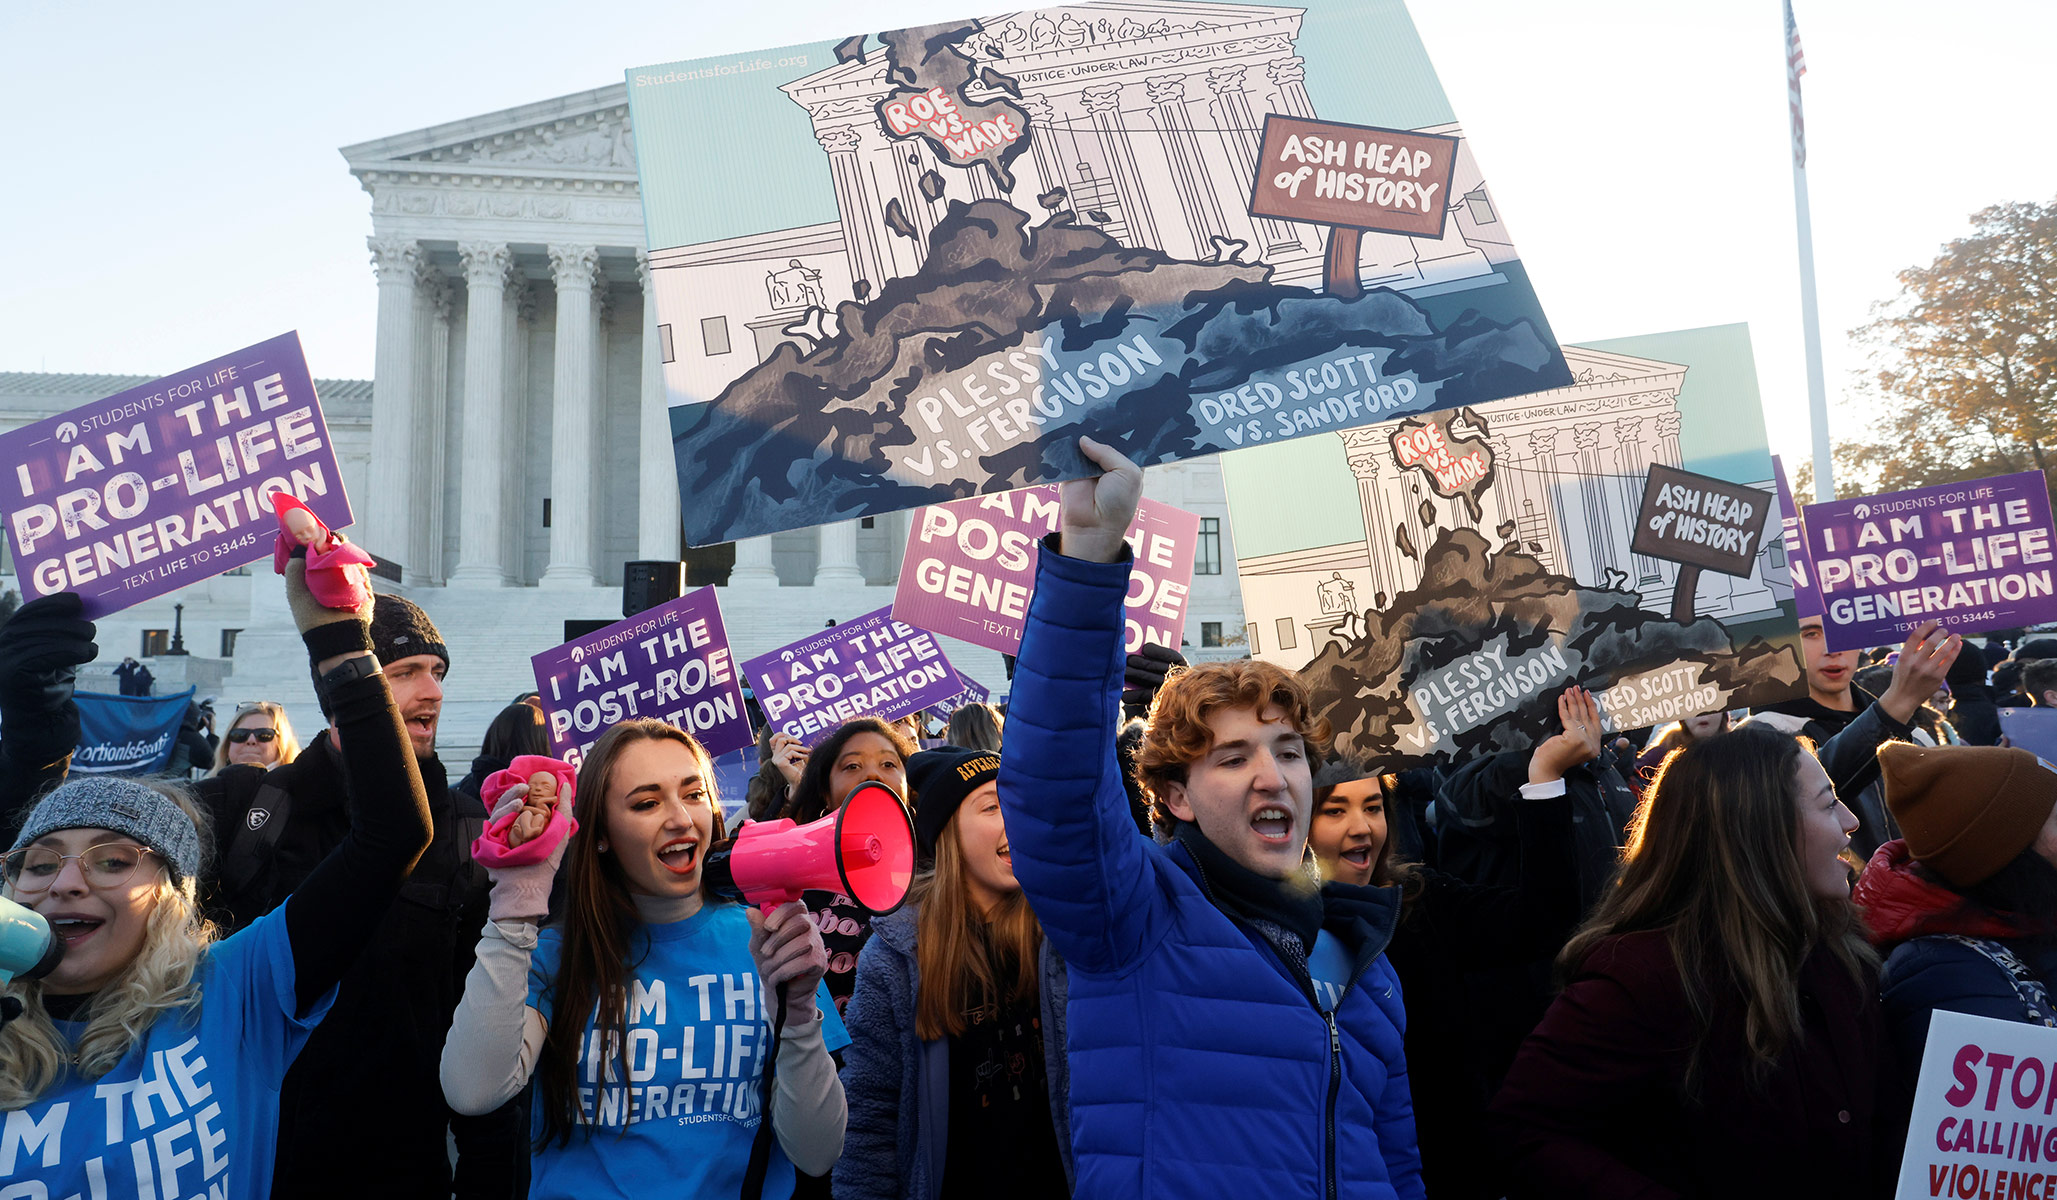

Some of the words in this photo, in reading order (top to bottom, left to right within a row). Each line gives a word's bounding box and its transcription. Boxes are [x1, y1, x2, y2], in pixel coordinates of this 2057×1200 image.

[636, 53, 808, 88] StudentsforLife.org
[886, 87, 957, 134] ROE
[942, 114, 1019, 159] WADE
[1280, 134, 1347, 166] ASH
[1354, 141, 1431, 177] HEAP
[1274, 166, 1313, 198] of
[1315, 168, 1439, 212] HISTORY
[81, 393, 164, 433] STUDENTS
[167, 379, 202, 402] FOR
[206, 366, 239, 389] LIFE
[916, 336, 1060, 434] PLESSY
[966, 333, 1164, 452] FERGUSON
[1199, 375, 1283, 427] DRED
[1288, 352, 1378, 401] SCOTT
[1278, 377, 1418, 436] SANDFORD
[16, 463, 33, 497] I
[64, 422, 152, 482] AM
[175, 372, 288, 437] THE
[1397, 422, 1447, 464] ROE
[11, 406, 322, 556] PRO-LIFE
[1435, 451, 1487, 491] WADE
[1656, 483, 1700, 513] ASH
[1703, 492, 1753, 526] HEAP
[1823, 528, 1835, 553] I
[1857, 515, 1924, 548] AM
[1943, 499, 2030, 534] THE
[1872, 496, 1936, 515] STUDENTS
[1939, 491, 1965, 504] FOR
[1969, 487, 1994, 499] LIFE
[33, 462, 328, 596] GENERATION
[1649, 511, 1676, 538] of
[1675, 514, 1754, 556] HISTORY
[122, 570, 155, 591] TEXT
[159, 560, 188, 578] LIFE
[190, 550, 210, 564] TO
[212, 533, 256, 557] 53445
[1818, 528, 2053, 594] PRO-LIFE
[1830, 570, 2053, 625] GENERATION
[1894, 621, 1918, 632] TEXT
[1946, 615, 1960, 626] TO
[1962, 611, 1996, 623] 53445
[585, 629, 634, 656] STUDENTS
[635, 620, 656, 635] FOR
[658, 611, 679, 628] LIFE
[795, 632, 842, 656] STUDENTS
[843, 623, 863, 637] FOR
[863, 616, 882, 629] LIFE
[982, 619, 1012, 637] TEXT
[550, 676, 561, 701] I
[577, 651, 628, 693] AM
[640, 618, 711, 665] THE
[761, 673, 774, 691] I
[791, 648, 840, 681] AM
[848, 621, 915, 654] THE
[763, 633, 939, 722] PRO-LIFE
[1414, 644, 1506, 716] PLESSY
[1640, 666, 1696, 701] SCOTT
[550, 648, 731, 743] POST-ROE
[781, 661, 947, 739] GENERATION
[886, 699, 911, 713] 53445
[1444, 646, 1568, 732] FERGUSON
[1631, 686, 1717, 728] SANDFORD
[94, 1035, 213, 1146] THE
[1945, 1044, 2057, 1116] STO
[1929, 1164, 2057, 1200] VIOLENCE
